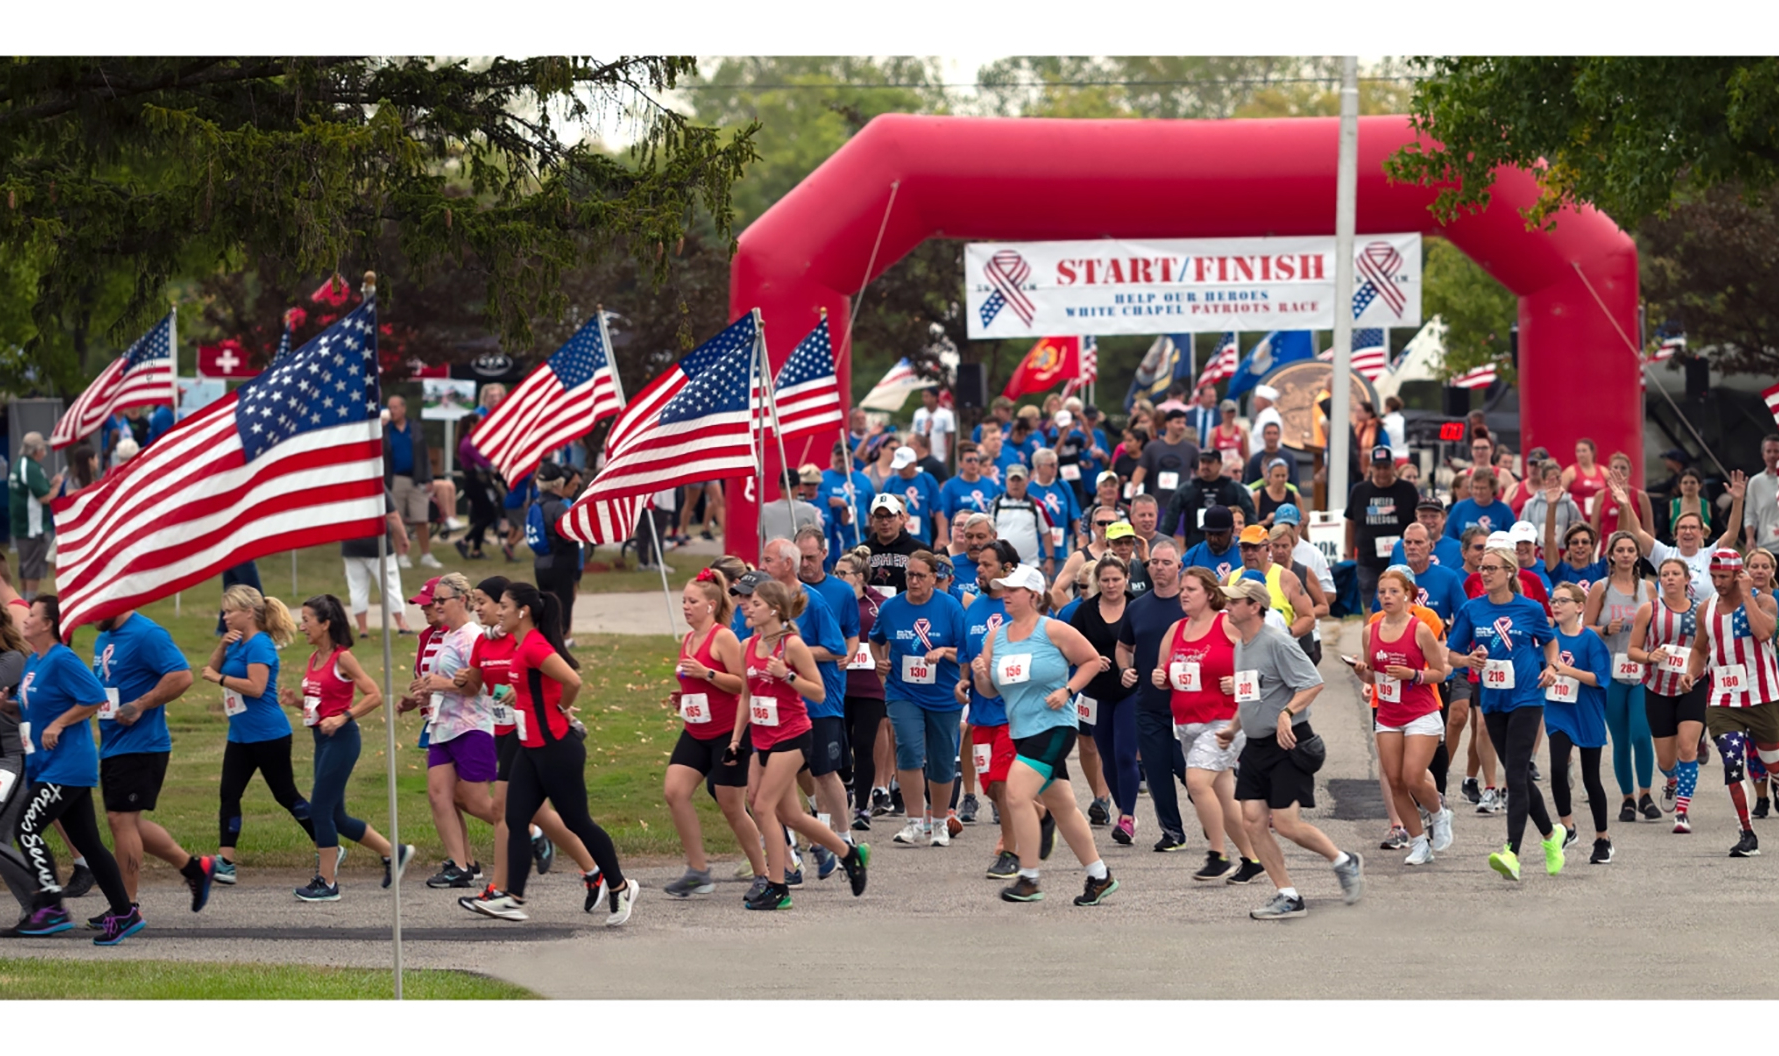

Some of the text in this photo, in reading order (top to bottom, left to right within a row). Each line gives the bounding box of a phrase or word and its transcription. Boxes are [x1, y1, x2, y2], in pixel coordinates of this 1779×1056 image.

[1056, 254, 1324, 285] START/FINISH
[1114, 290, 1269, 304] HELP OUR HEROES
[1065, 301, 1320, 317] WHITE CHAPEL PATRIOTS RACE
[1668, 655, 1684, 667] 179
[909, 666, 927, 678] 130
[1620, 663, 1639, 674] 283
[1178, 673, 1192, 685] 157
[1488, 670, 1505, 683] 218
[1721, 675, 1739, 687] 180
[1554, 684, 1569, 696] 110
[685, 706, 701, 718] 185
[752, 707, 769, 720] 186
